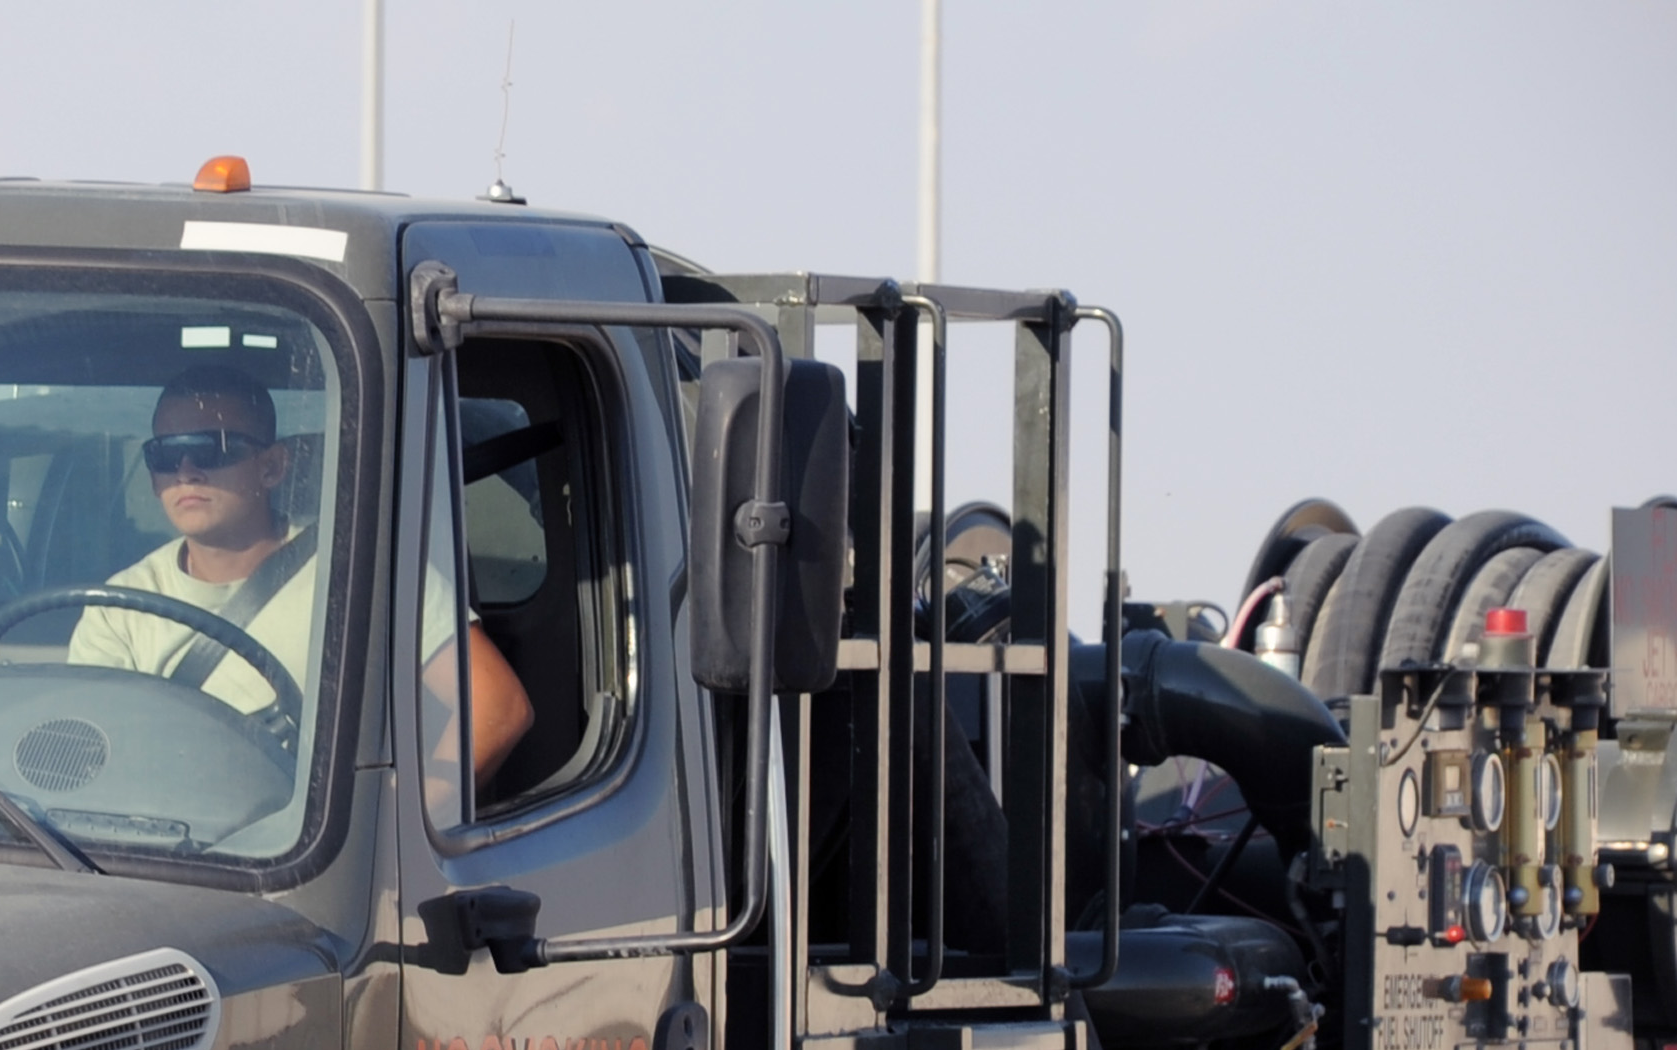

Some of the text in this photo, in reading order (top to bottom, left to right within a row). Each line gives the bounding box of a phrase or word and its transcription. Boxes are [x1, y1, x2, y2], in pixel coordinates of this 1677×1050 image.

[1383, 974, 1440, 1009] EMERGE
[1377, 1014, 1444, 1050] FUEL SHUTOFF
